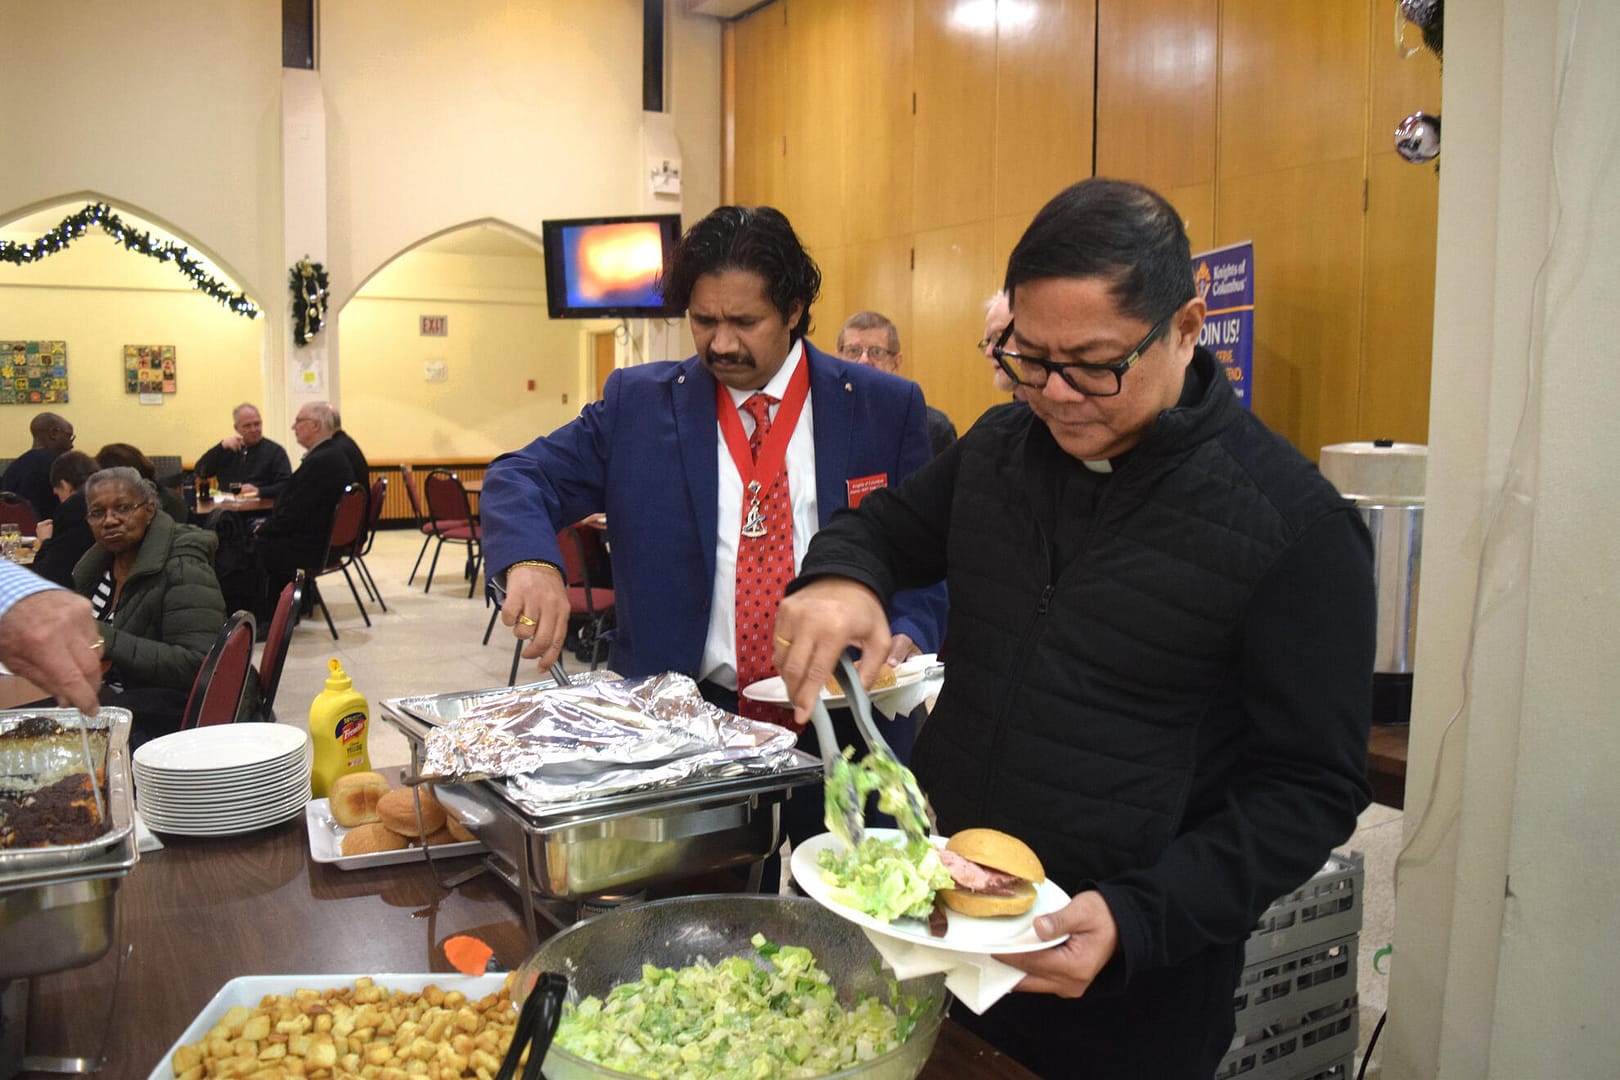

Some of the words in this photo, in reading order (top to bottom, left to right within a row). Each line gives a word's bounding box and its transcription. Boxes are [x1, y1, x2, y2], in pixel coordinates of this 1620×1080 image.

[1213, 264, 1238, 281] Knights
[1238, 259, 1246, 275] of
[1213, 278, 1245, 297] Columbus
[423, 317, 445, 334] EXIT
[1222, 318, 1240, 345] US!
